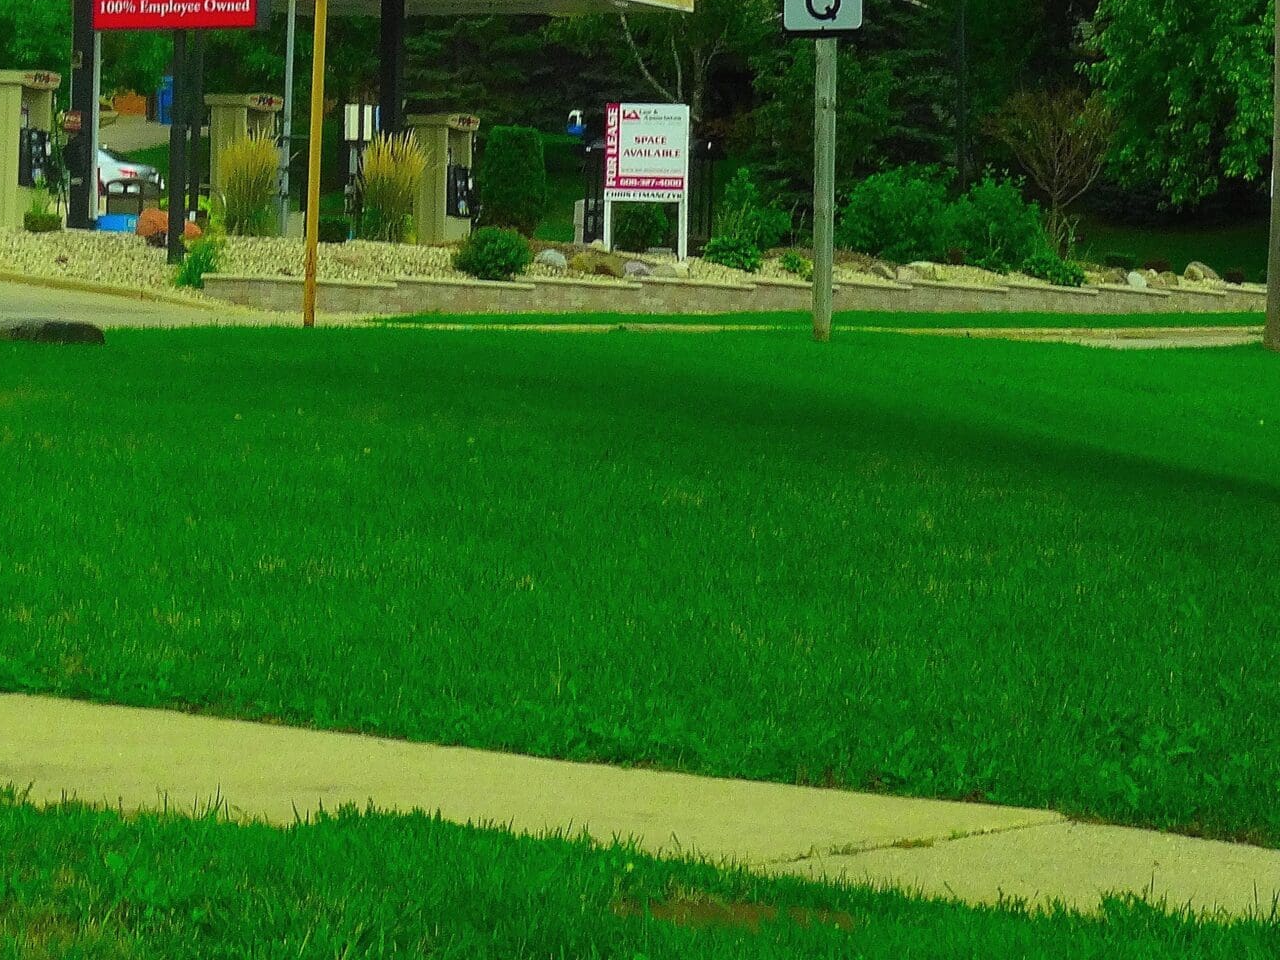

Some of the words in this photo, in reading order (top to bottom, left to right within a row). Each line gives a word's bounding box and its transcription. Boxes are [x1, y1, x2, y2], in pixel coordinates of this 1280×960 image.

[100, 0, 136, 15] 100%
[607, 107, 619, 155] LEASE
[634, 135, 667, 145] SPACE
[624, 148, 681, 158] AVAILABLE
[606, 156, 617, 188] FOR
